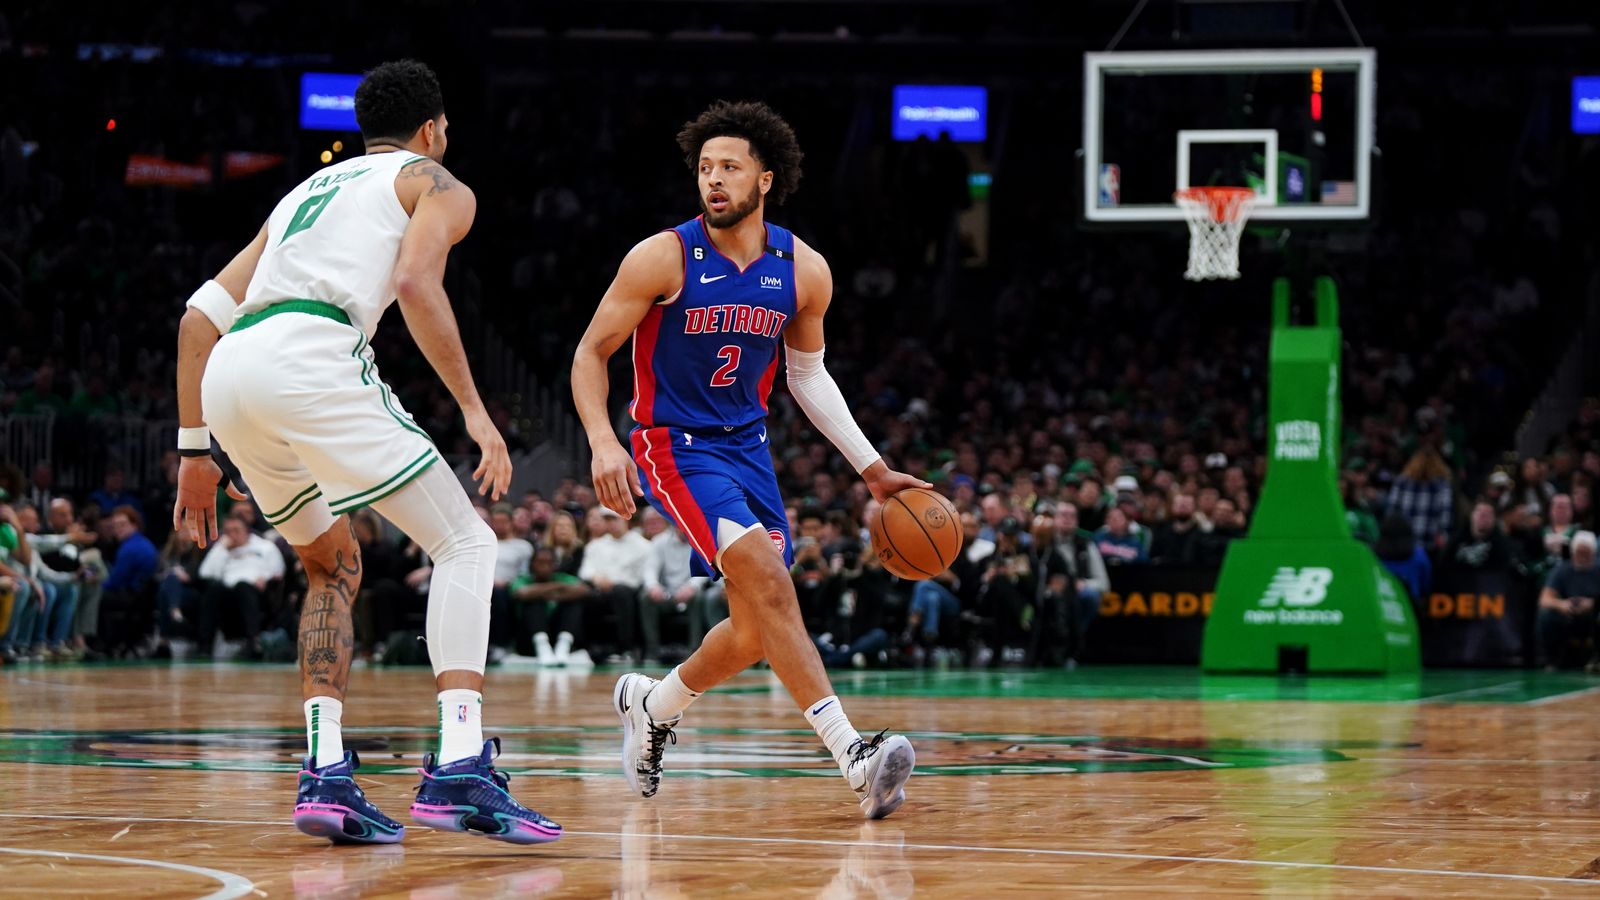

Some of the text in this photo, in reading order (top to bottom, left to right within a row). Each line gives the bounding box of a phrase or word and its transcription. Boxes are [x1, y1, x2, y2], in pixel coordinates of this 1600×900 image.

[277, 185, 341, 248] 0
[693, 246, 704, 261] 6
[760, 276, 782, 287] UWM
[684, 304, 788, 338] DETROIT
[710, 344, 742, 388] 2
[1243, 607, 1344, 625] new balance
